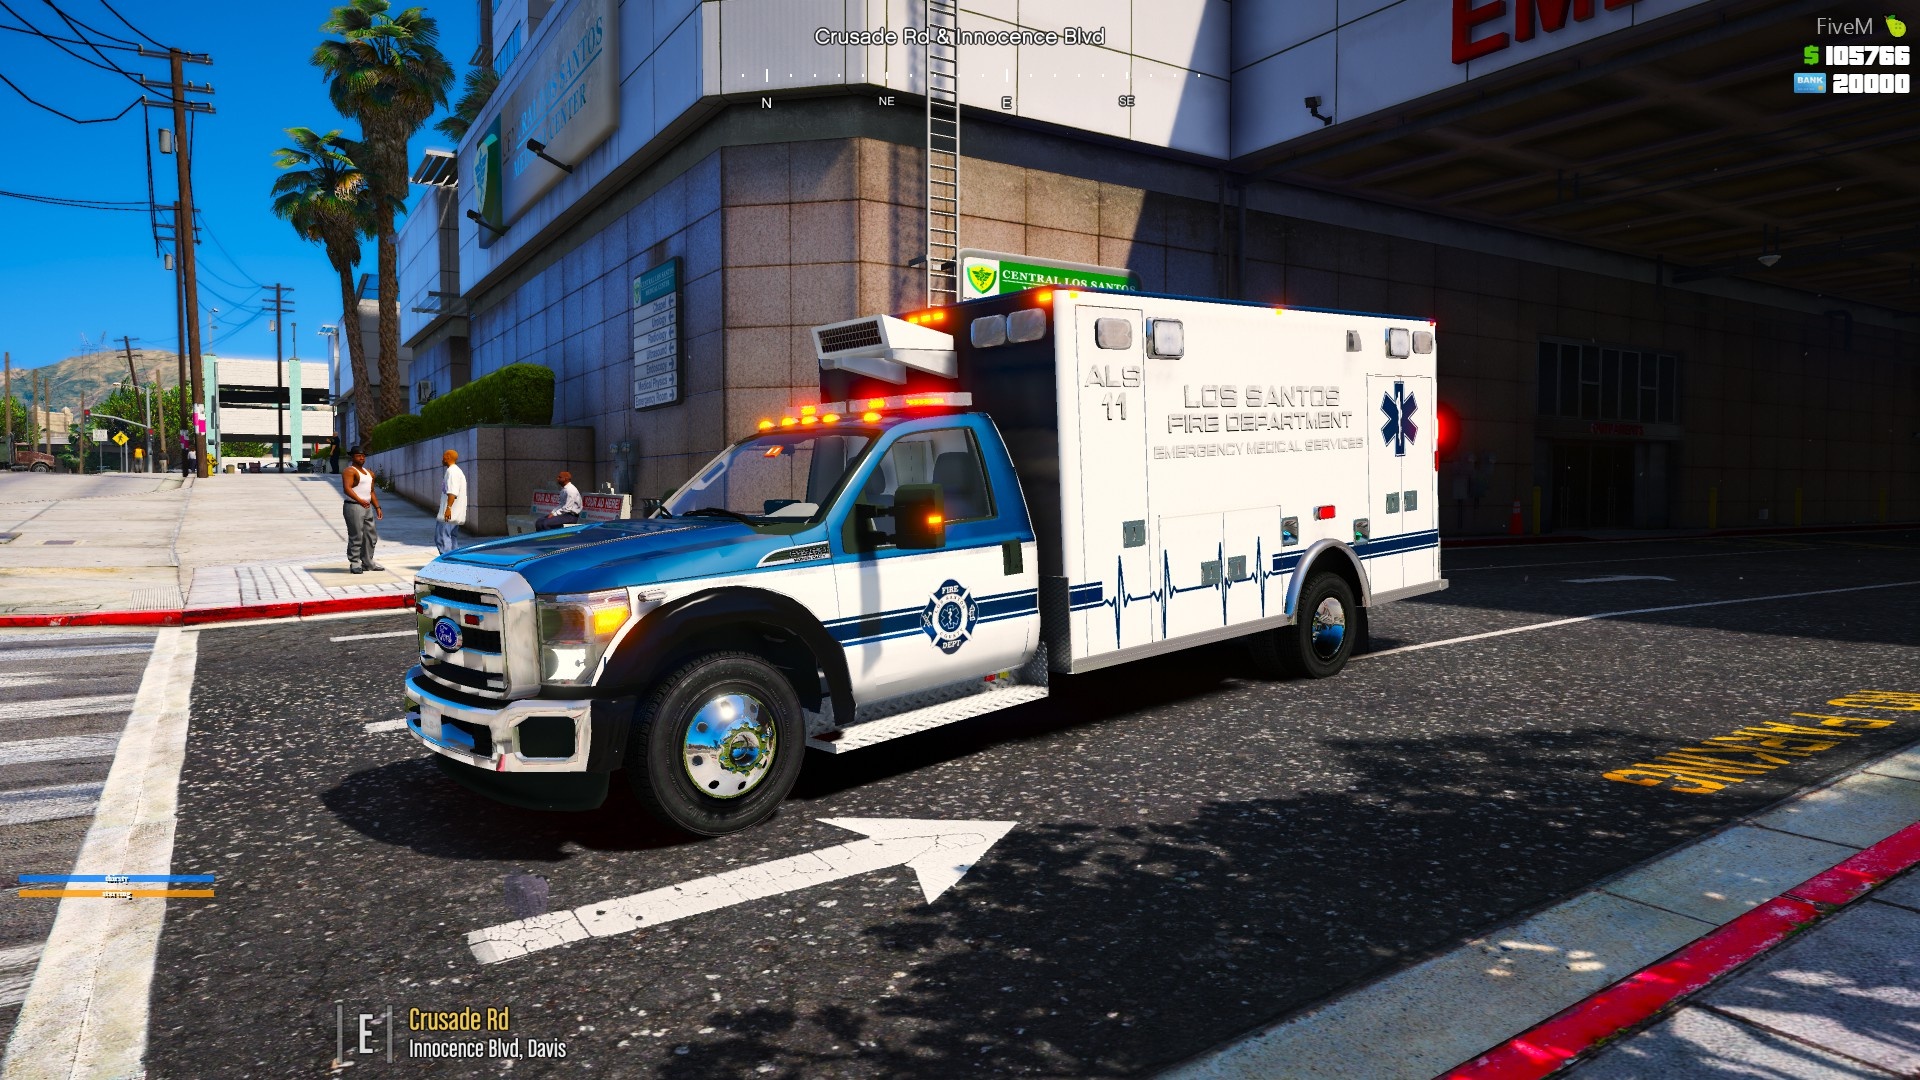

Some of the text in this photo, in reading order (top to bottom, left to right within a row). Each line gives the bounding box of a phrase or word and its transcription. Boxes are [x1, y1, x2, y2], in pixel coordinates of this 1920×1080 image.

[559, 16, 603, 90] SANTOS
[1002, 269, 1061, 286] CENTRAL
[1065, 278, 1087, 288] LOS
[1084, 364, 1141, 388] ALS
[1101, 391, 1127, 421] 11
[1184, 384, 1340, 409] LOS SANTOS
[1167, 411, 1353, 434] FIRE DEPARTMENT
[1153, 436, 1364, 459] EMERGENCY MEDICAL SERVICES
[941, 585, 959, 595] FIRE
[942, 639, 962, 649] DEPT
